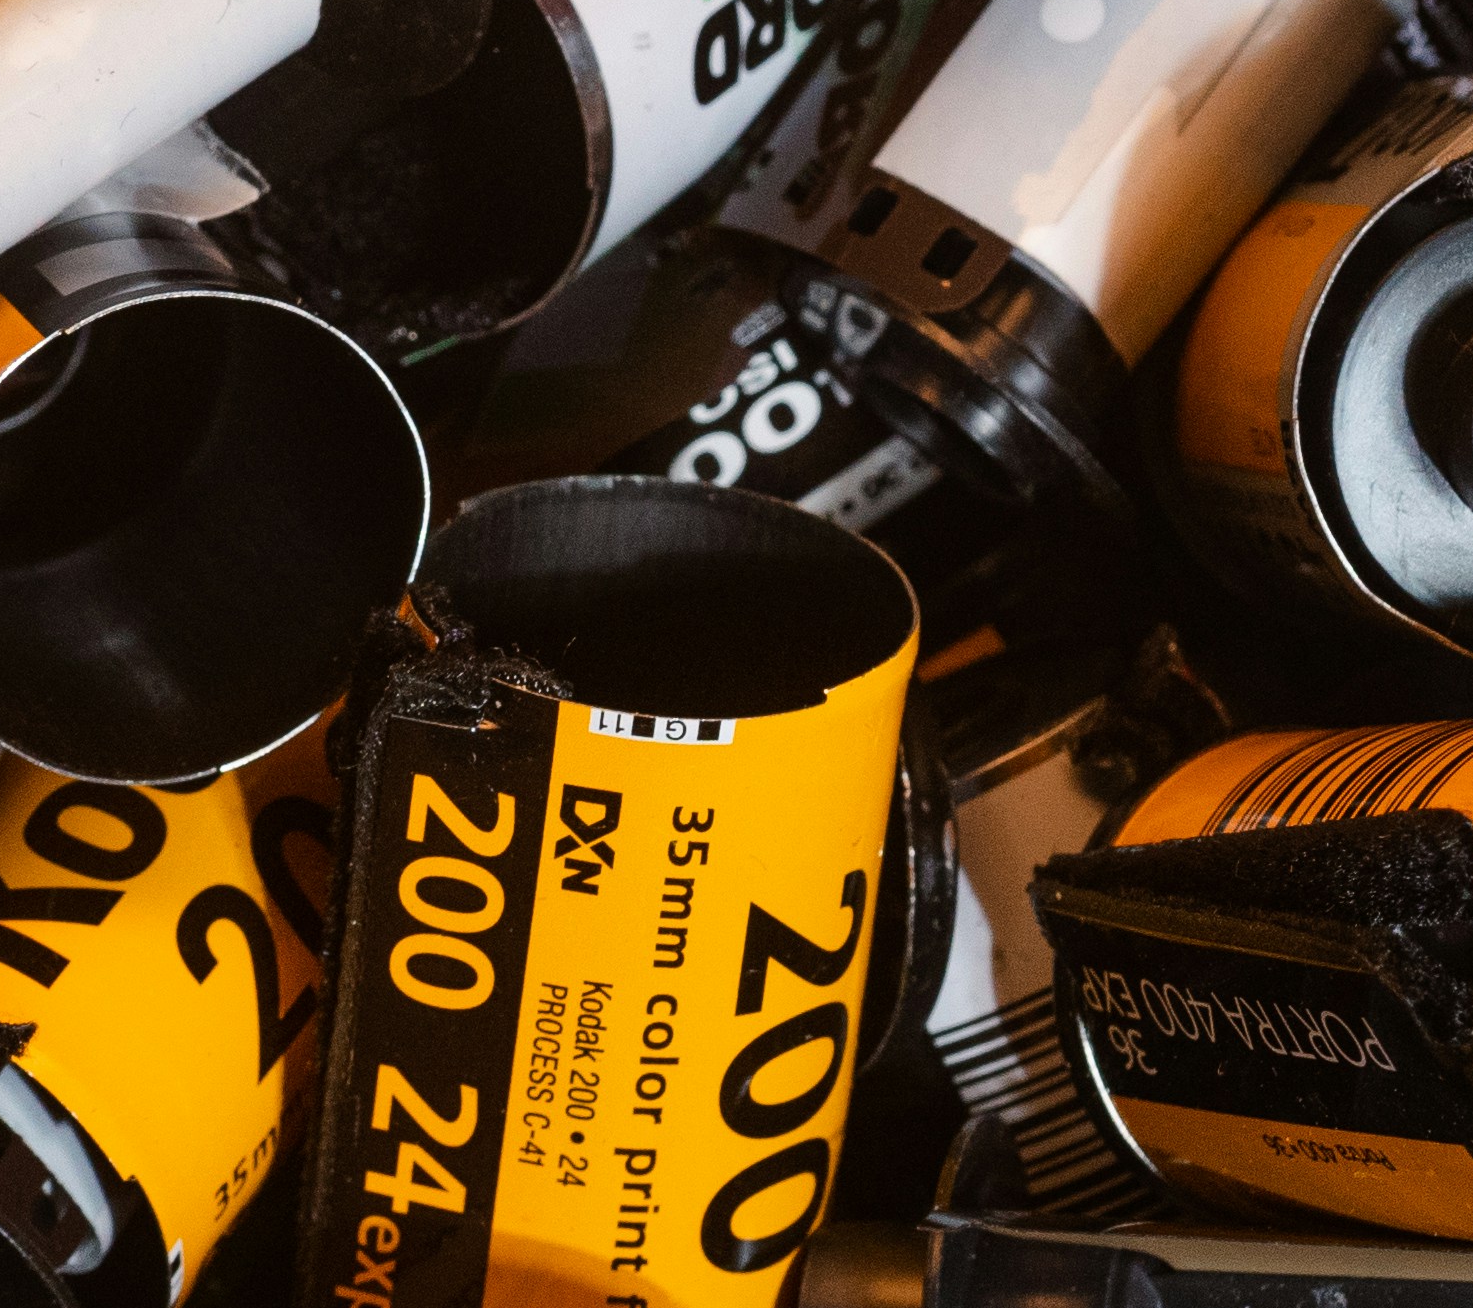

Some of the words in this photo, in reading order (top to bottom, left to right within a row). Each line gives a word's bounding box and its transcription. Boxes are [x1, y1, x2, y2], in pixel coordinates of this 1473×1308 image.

[664, 719, 688, 741] G
[388, 772, 516, 1011] 200
[652, 805, 717, 970] 35mm
[572, 979, 614, 1063] Kodak
[1082, 965, 1140, 1021] EXP
[1141, 977, 1216, 1042] 400
[525, 981, 569, 1104] PROCESS
[632, 993, 681, 1125] color
[699, 867, 869, 1274] 200
[1107, 1022, 1157, 1076] 36
[1223, 997, 1397, 1072] PORTRA
[564, 1068, 601, 1122] 200
[361, 1062, 480, 1218] 24
[517, 1111, 552, 1168] C-41
[556, 1153, 590, 1188] 24
[610, 1146, 661, 1272] print
